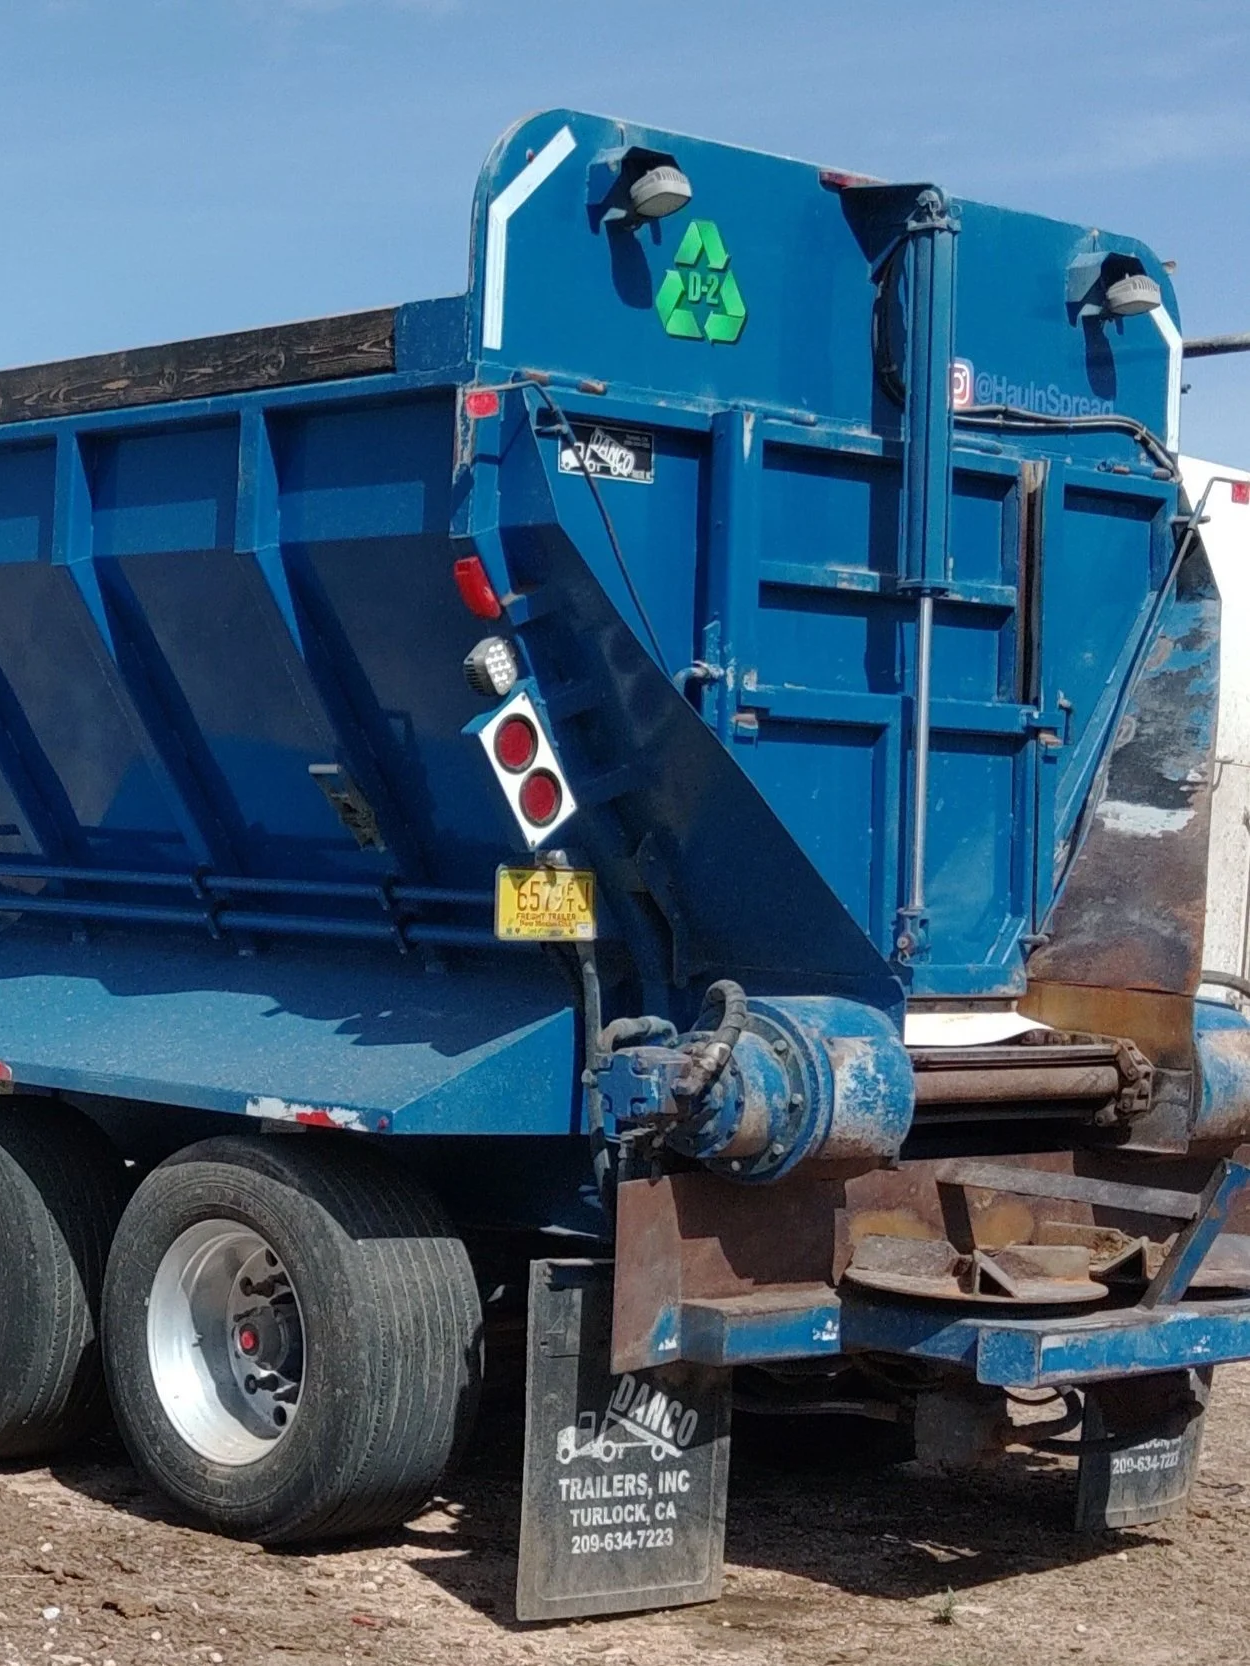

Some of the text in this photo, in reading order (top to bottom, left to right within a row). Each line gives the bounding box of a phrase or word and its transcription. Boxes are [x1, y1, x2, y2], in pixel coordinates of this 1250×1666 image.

[688, 271, 719, 305] D-2
[612, 1373, 699, 1447] DANCO
[558, 1469, 691, 1501] TRAILERS, INC
[570, 1500, 677, 1527] TURLOCK, CA
[571, 1527, 675, 1555] 209-634-7223
